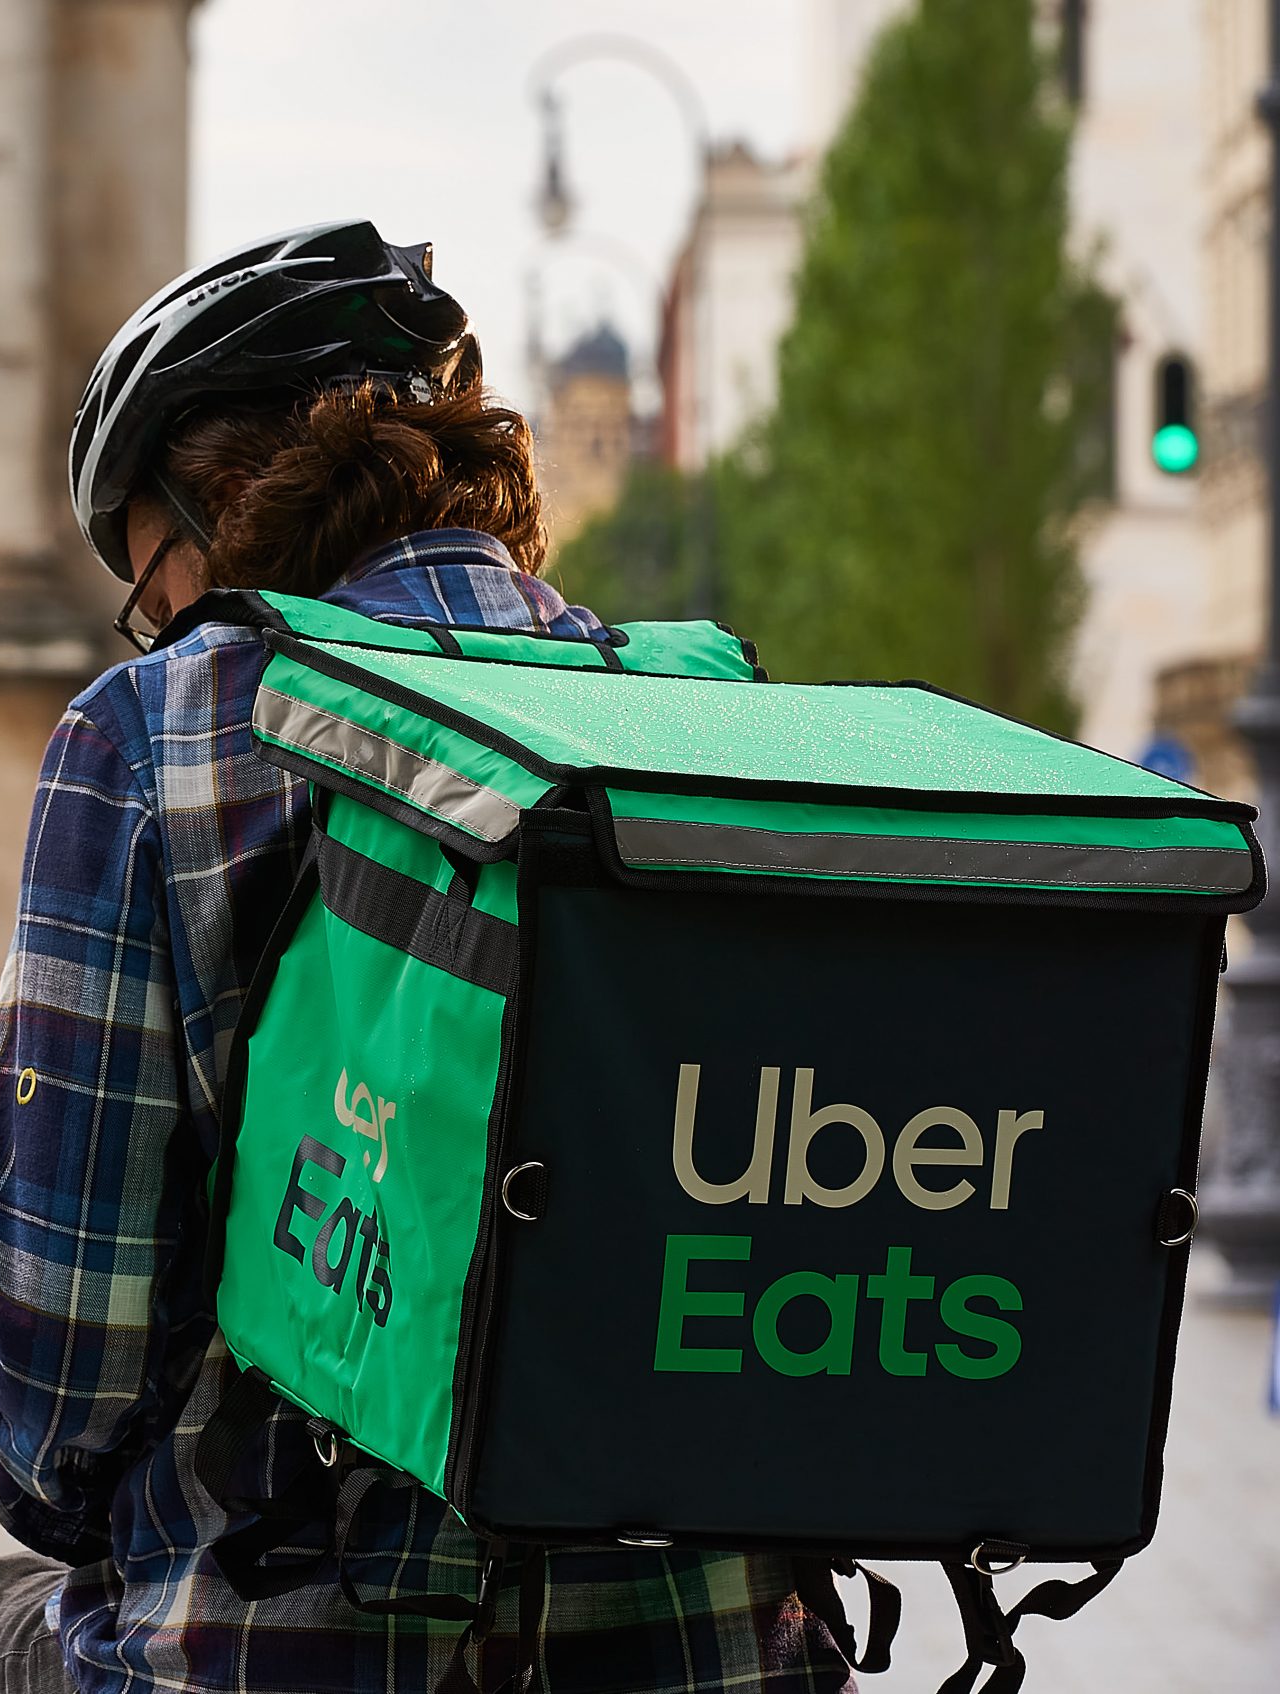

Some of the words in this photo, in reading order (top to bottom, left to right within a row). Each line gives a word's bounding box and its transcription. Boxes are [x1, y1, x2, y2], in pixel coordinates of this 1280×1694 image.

[673, 1063, 1044, 1210] Uber
[273, 1133, 393, 1328] Eats
[653, 1234, 1023, 1379] Eats
